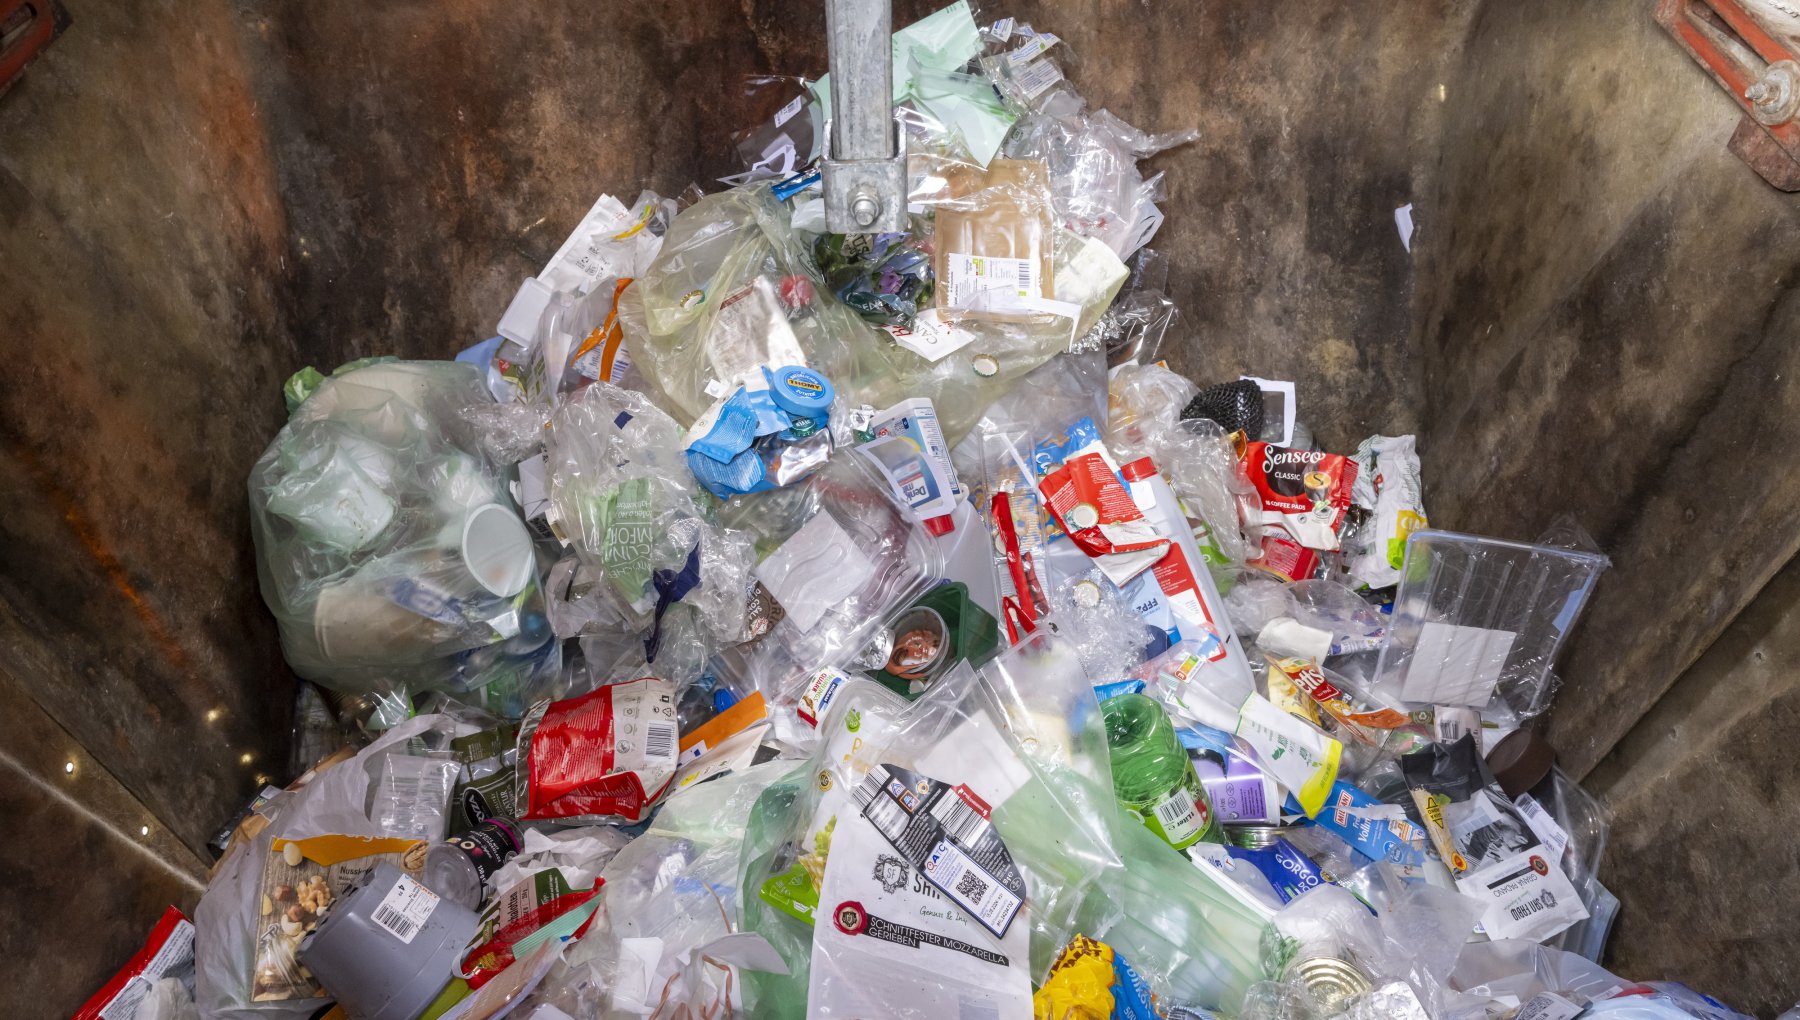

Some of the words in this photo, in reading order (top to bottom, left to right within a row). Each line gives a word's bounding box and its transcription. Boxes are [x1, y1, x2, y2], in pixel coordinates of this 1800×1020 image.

[1262, 445, 1326, 473] Senseo
[1274, 470, 1301, 481] CLASSIC
[905, 485, 928, 502] Denk
[1271, 500, 1290, 509] COFFEE
[1291, 502, 1306, 511] PADS
[1136, 598, 1159, 614] FFP2
[811, 672, 828, 693] QUARK
[823, 682, 839, 704] MILRAM
[1334, 792, 1351, 825] MILANI
[1492, 881, 1519, 898] PADANO
[1515, 872, 1539, 888] GRANA
[1510, 902, 1533, 922] FABIO
[1528, 896, 1545, 915] SAN
[868, 926, 918, 949] GERIEBEN
[870, 917, 942, 946] SCHNITTFESTER
[942, 937, 1006, 966] MOZZARELLA
